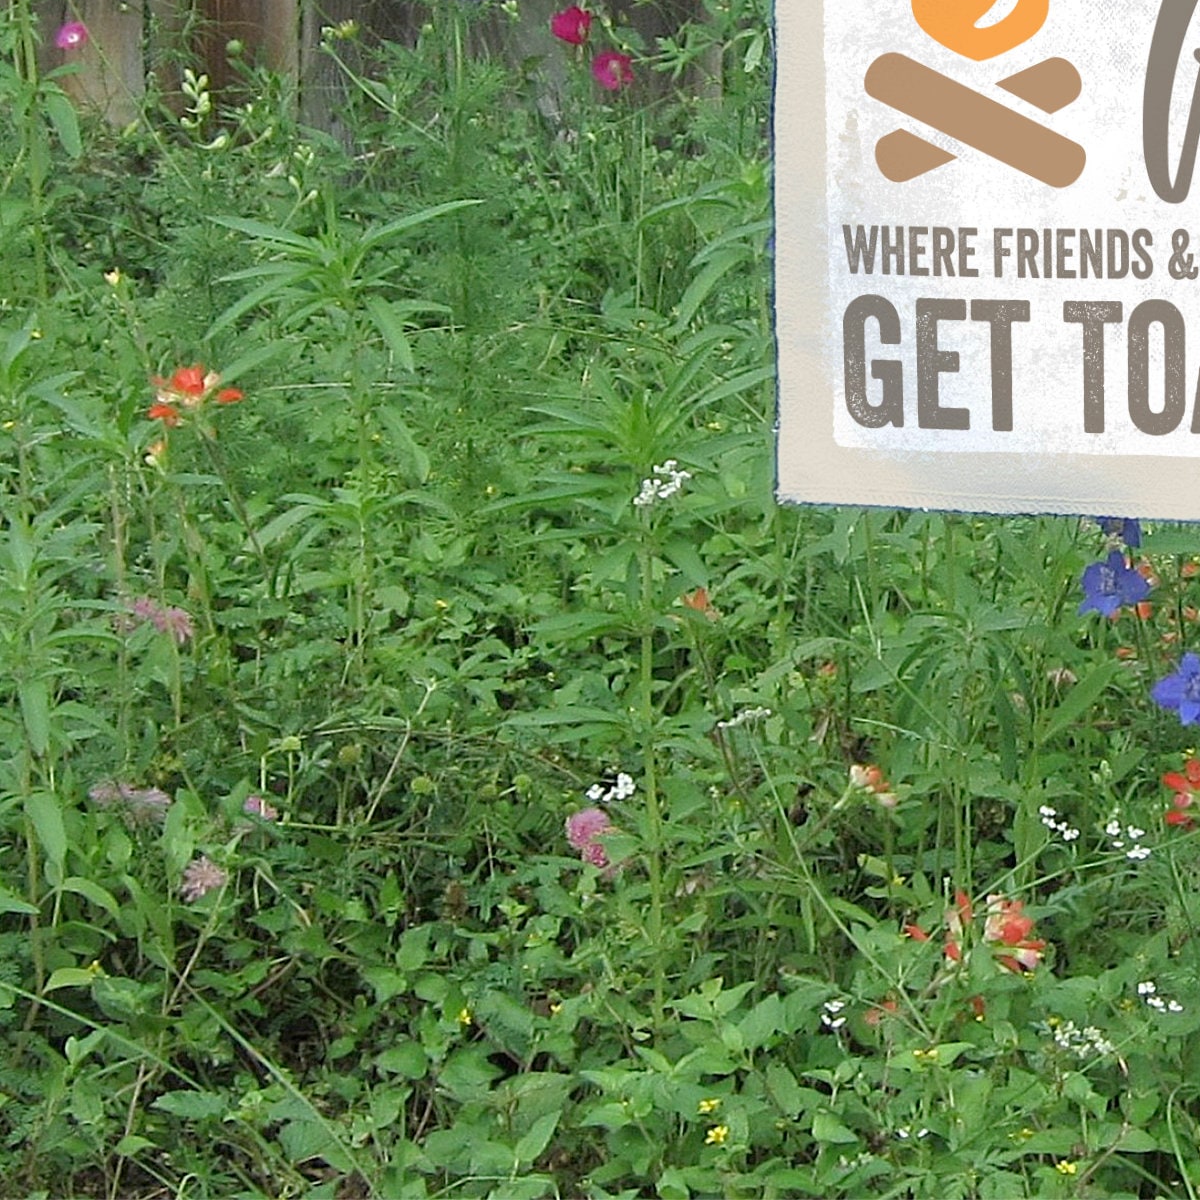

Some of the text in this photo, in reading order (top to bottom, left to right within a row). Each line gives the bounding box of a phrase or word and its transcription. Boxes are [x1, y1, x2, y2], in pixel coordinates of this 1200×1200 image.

[842, 225, 978, 279] WHERE
[994, 227, 1153, 280] FRIENDS
[1168, 228, 1199, 281] &
[843, 293, 1030, 432] GET
